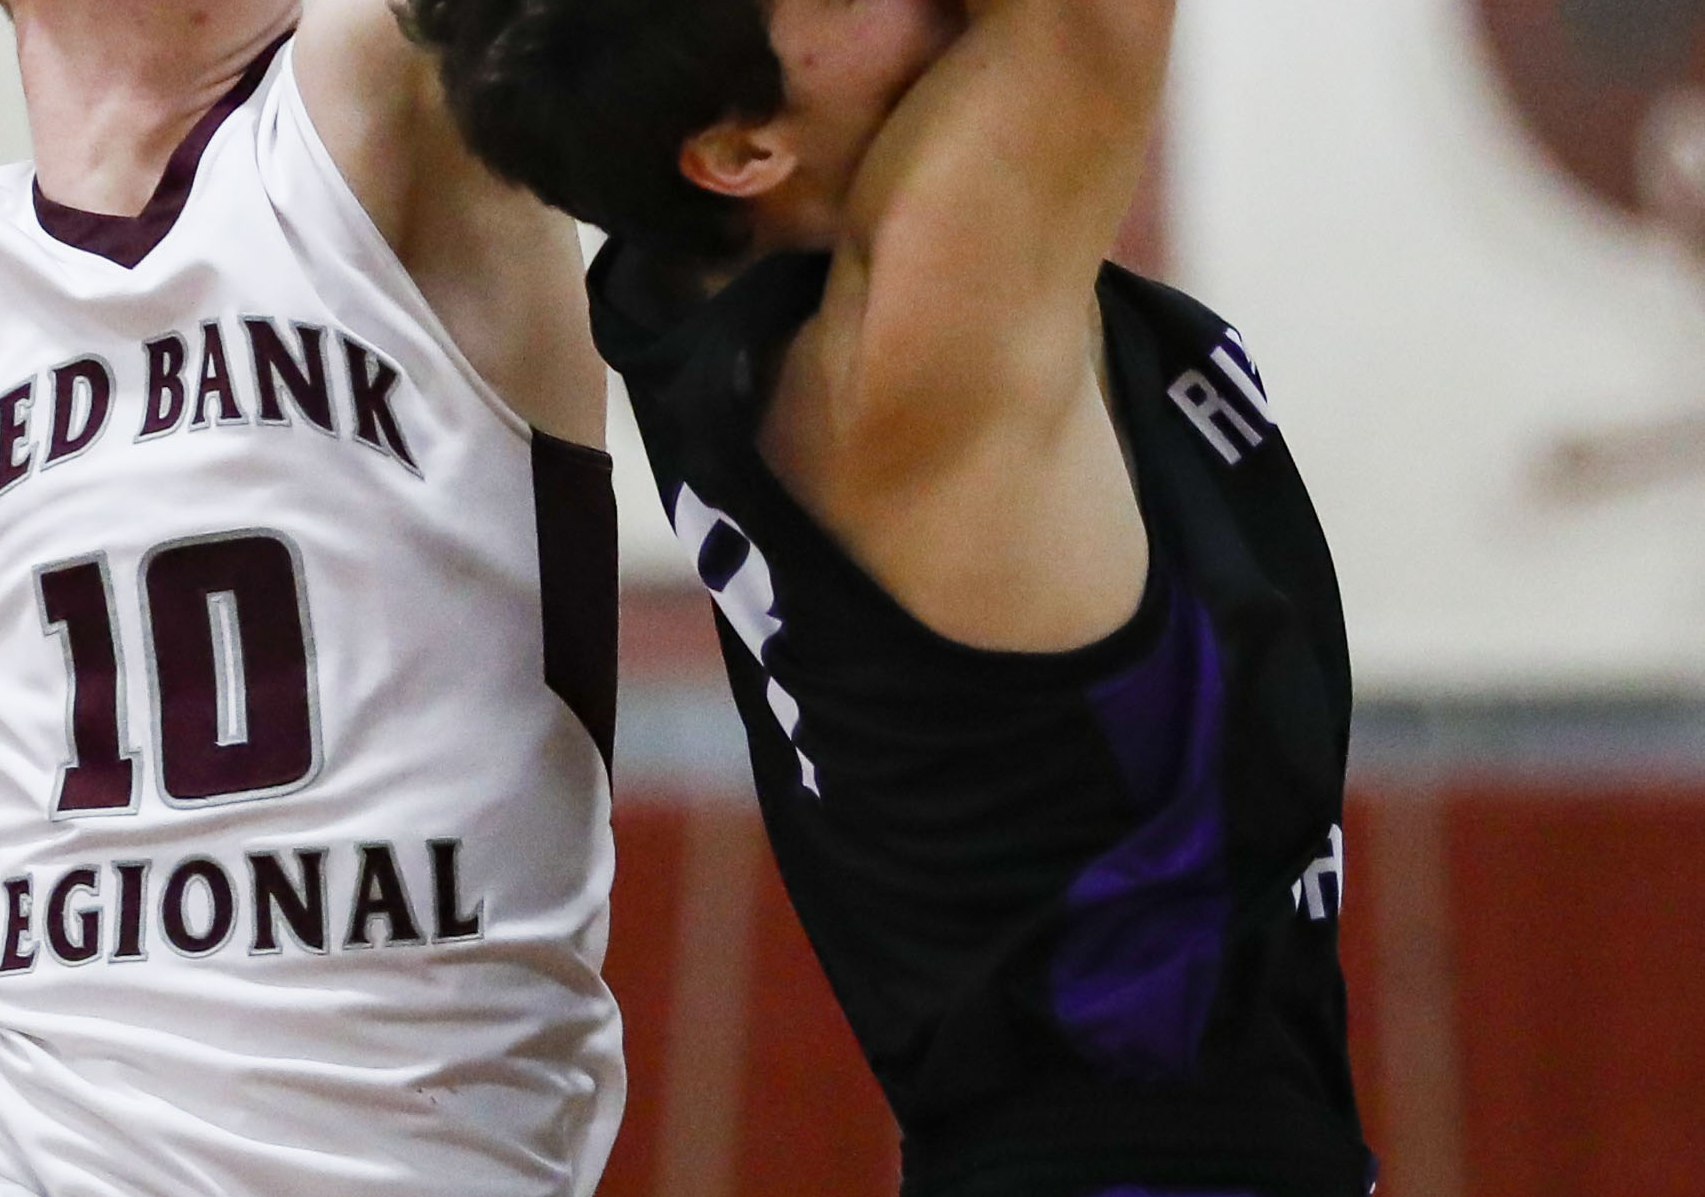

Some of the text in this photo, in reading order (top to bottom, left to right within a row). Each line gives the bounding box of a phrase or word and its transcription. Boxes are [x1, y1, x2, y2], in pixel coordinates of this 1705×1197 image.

[134, 315, 425, 482] BANK
[1167, 327, 1278, 465] RI
[32, 527, 326, 821] 10
